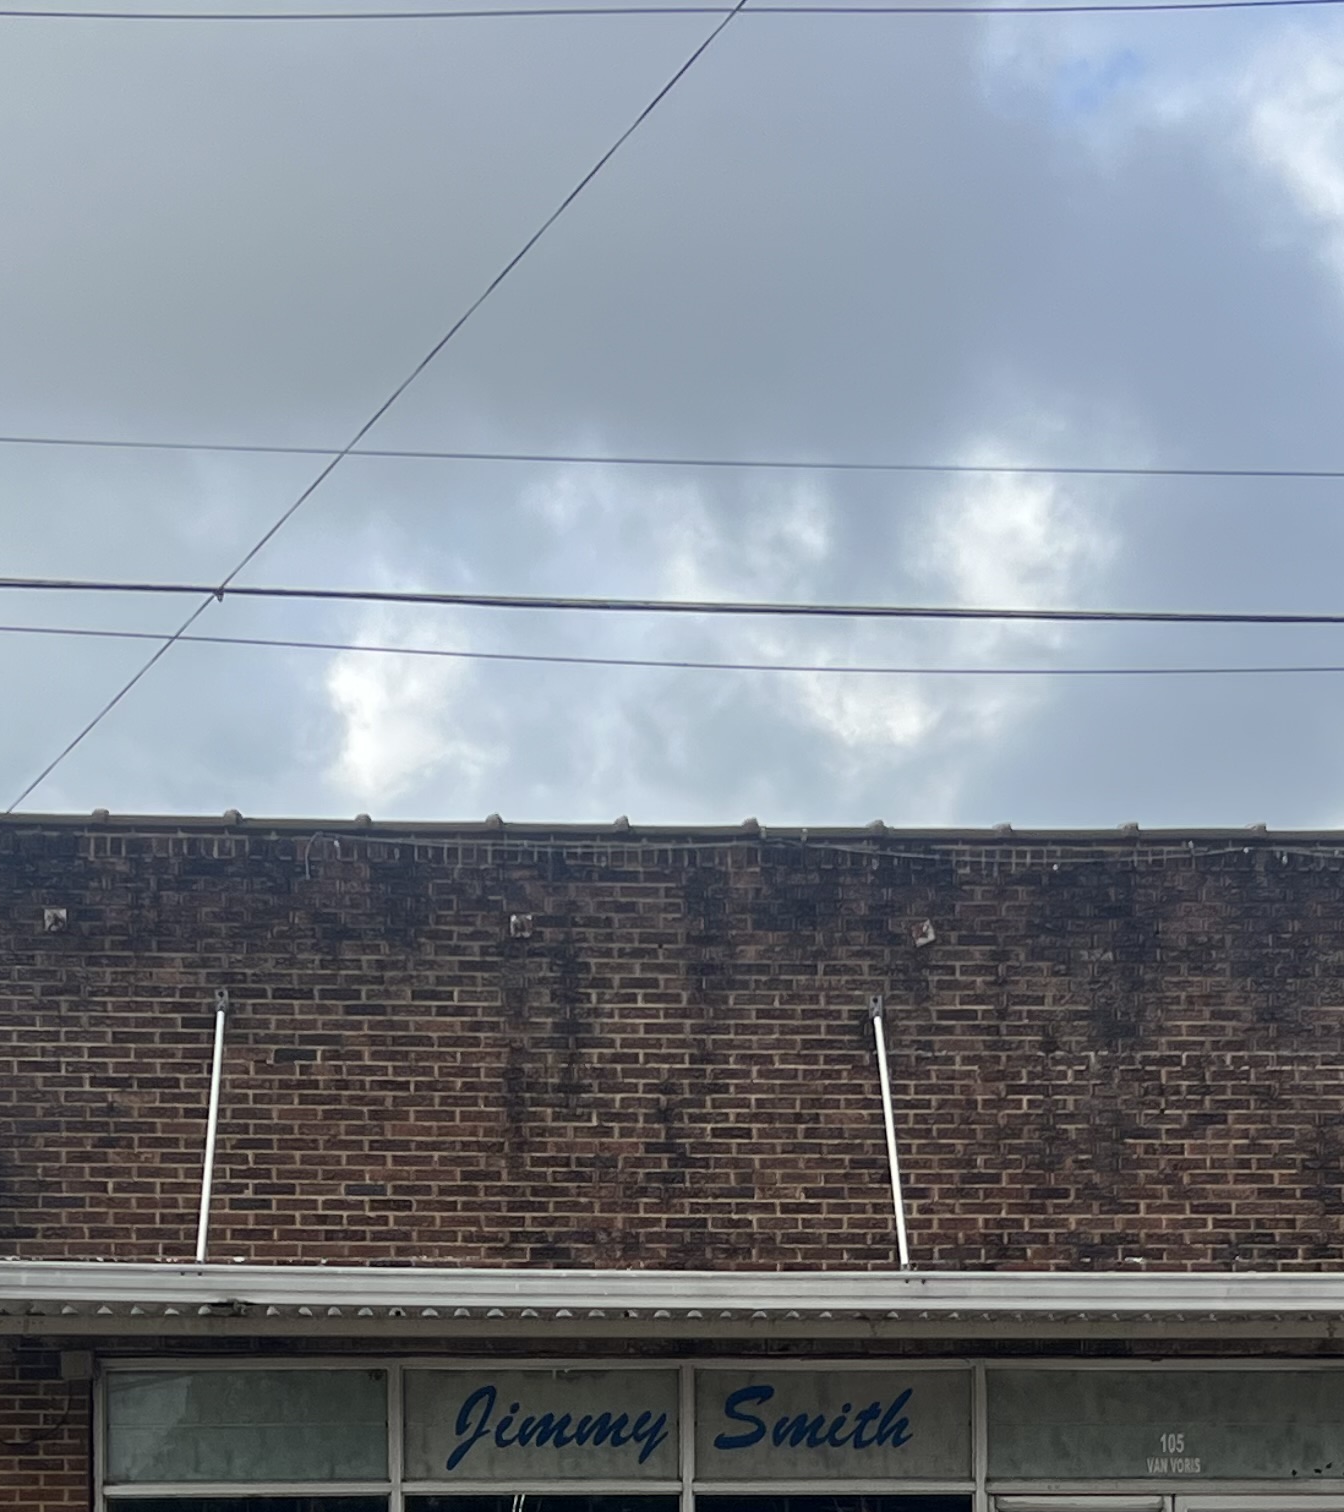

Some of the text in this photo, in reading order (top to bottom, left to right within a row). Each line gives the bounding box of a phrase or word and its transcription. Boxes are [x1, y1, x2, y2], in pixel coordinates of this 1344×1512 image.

[445, 1384, 913, 1471] Jimmy Smith
[1160, 1432, 1185, 1453] 105
[1146, 1457, 1201, 1473] VAN VORIS
